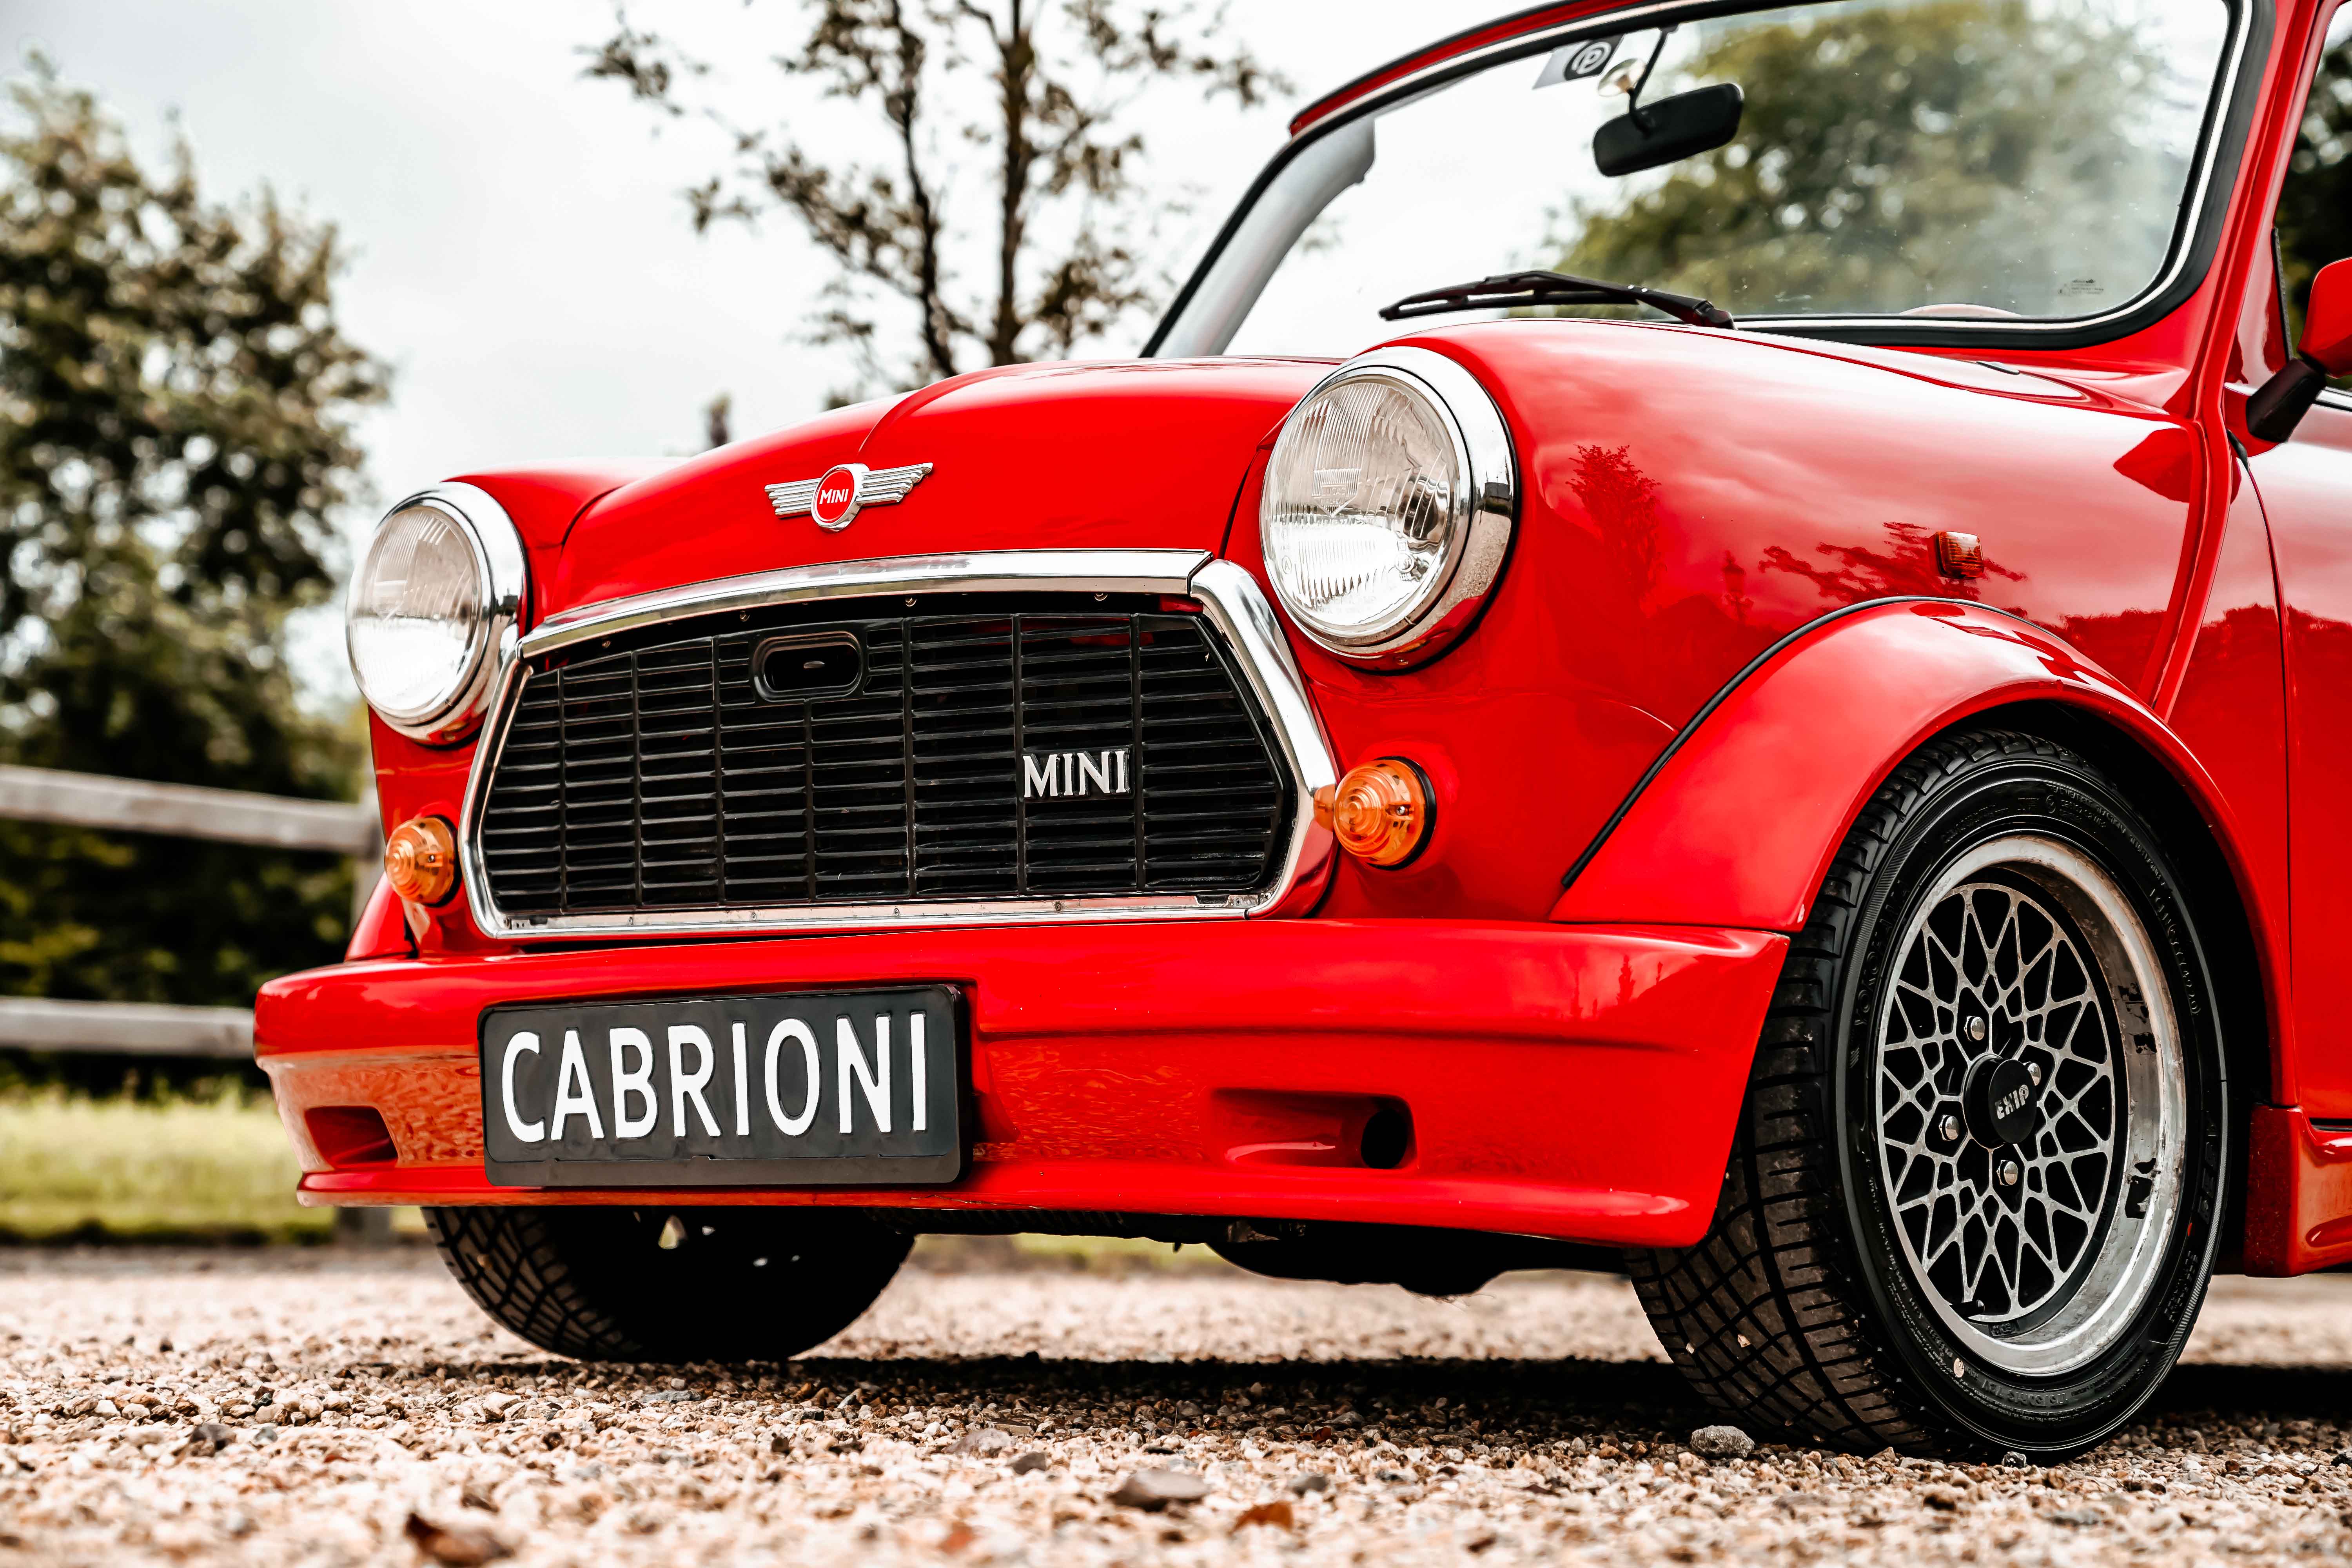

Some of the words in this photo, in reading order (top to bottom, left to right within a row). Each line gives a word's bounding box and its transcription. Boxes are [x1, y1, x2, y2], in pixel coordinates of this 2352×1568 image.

[819, 488, 849, 505] MINI
[1022, 750, 1126, 798] MINI
[501, 1011, 927, 1143] CABRIONI
